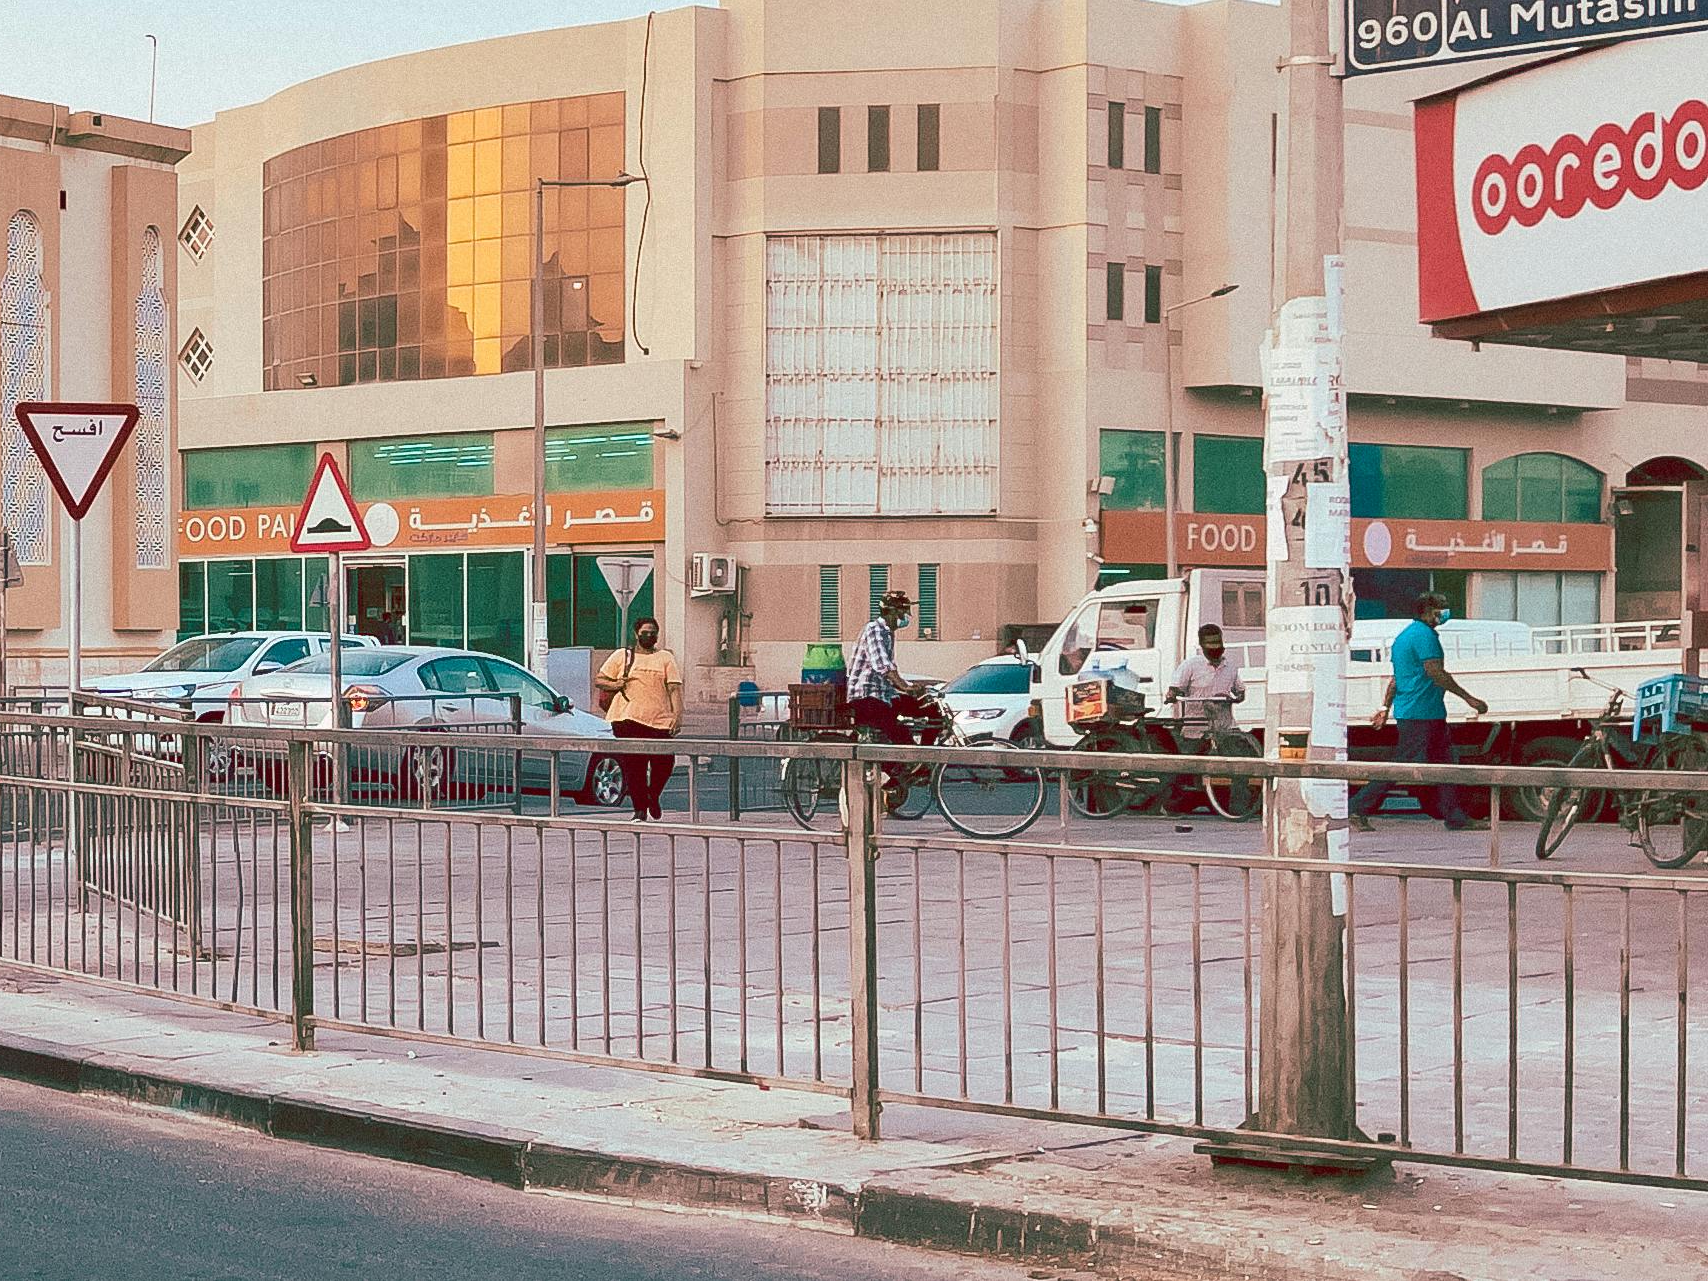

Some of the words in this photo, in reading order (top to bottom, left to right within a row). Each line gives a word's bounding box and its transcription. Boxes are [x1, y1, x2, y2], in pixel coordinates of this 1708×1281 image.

[1357, 11, 1438, 49] 960
[1448, 8, 1493, 44] Al
[52, 419, 103, 443] افسح
[1291, 462, 1330, 487] 45
[409, 502, 553, 533] اغذية
[563, 501, 655, 530] قصر
[1187, 523, 1257, 552] FOOD
[1405, 528, 1506, 557] الأغذية
[1509, 534, 1568, 557] قصر
